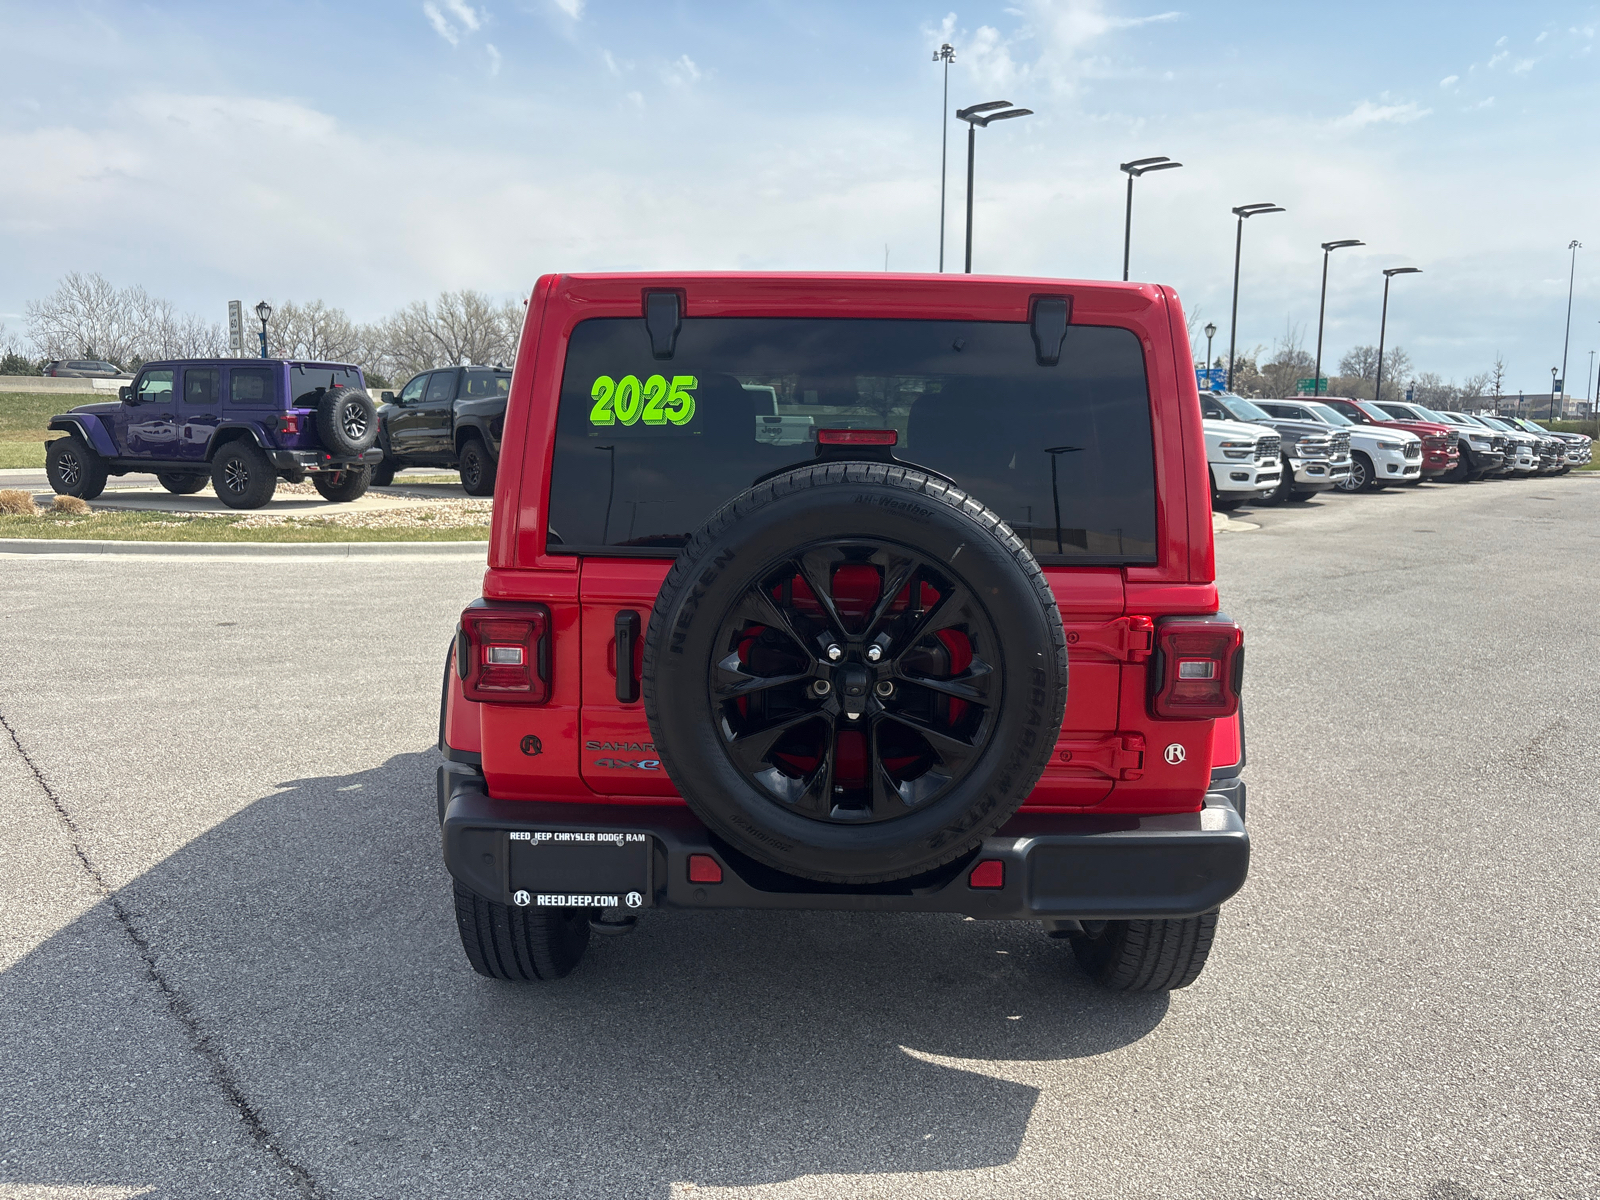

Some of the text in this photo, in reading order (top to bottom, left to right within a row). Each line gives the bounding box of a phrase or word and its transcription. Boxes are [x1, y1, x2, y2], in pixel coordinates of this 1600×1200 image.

[230, 319, 238, 329] 60
[590, 374, 699, 427] 2025
[761, 426, 783, 436] Jeep
[669, 547, 736, 655] NEXEN
[585, 740, 656, 752] SAHAR
[510, 831, 531, 841] REED
[554, 832, 596, 842] CHRYSLER
[626, 833, 646, 842] RAM
[537, 894, 619, 907] REEDJEEP.COM
